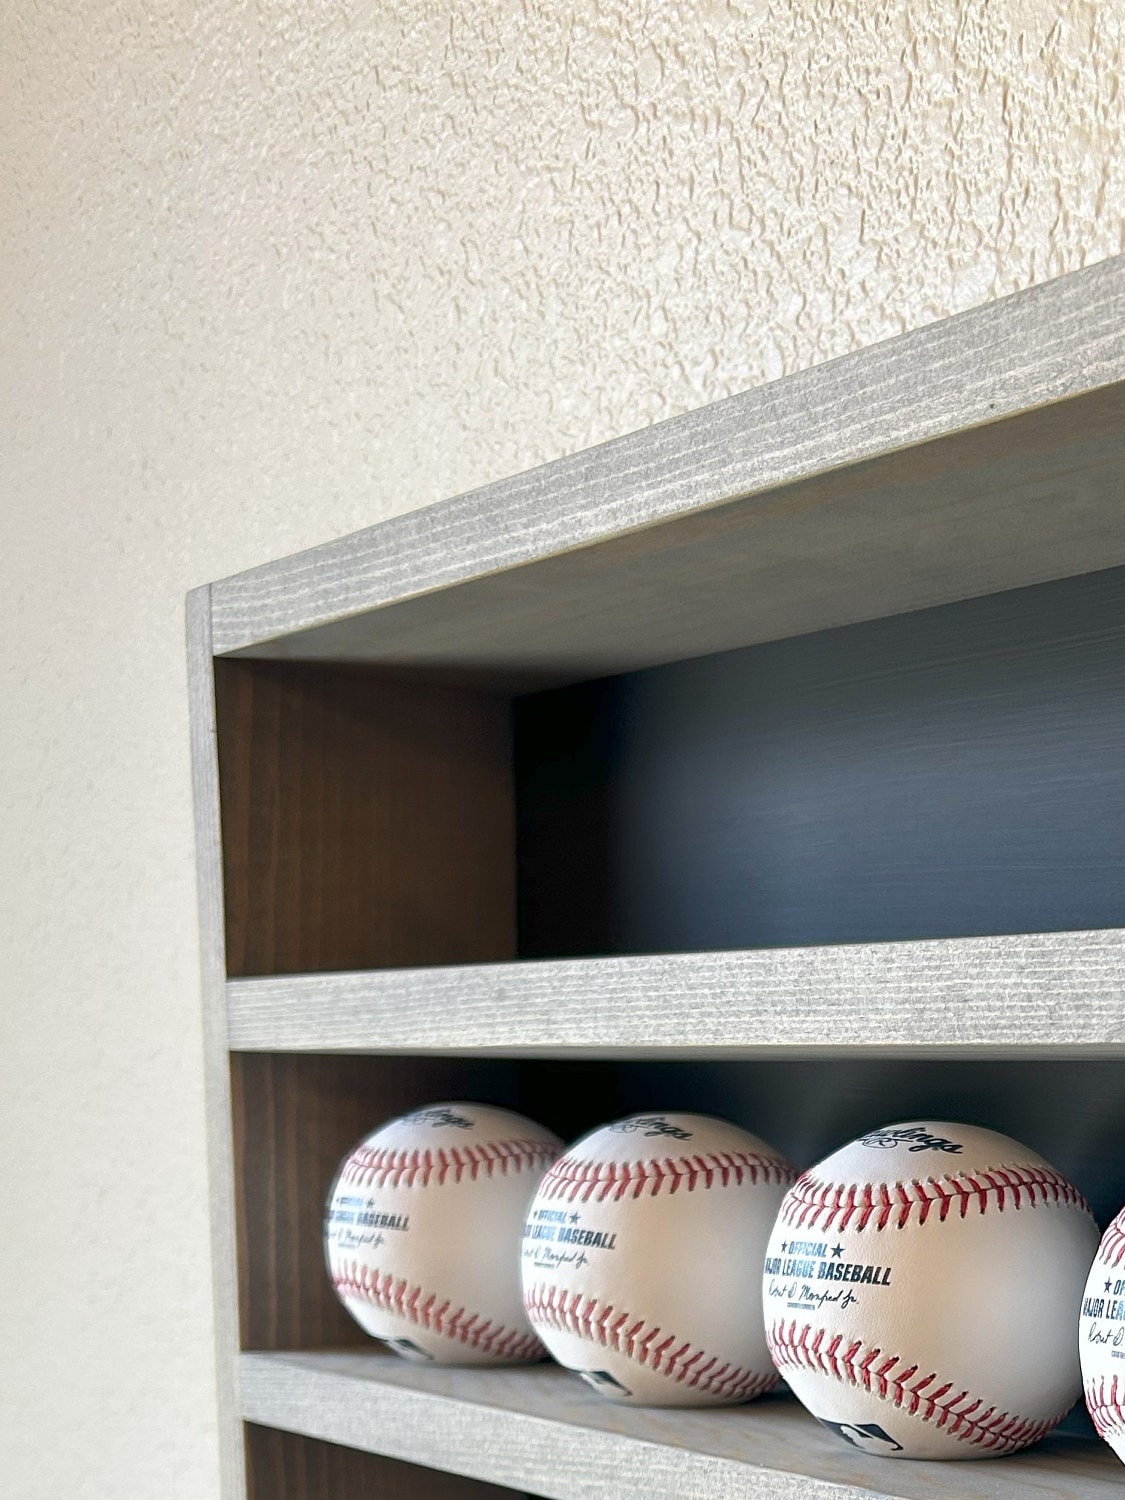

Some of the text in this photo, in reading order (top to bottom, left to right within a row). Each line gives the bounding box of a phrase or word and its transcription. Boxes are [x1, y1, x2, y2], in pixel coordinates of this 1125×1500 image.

[557, 1227, 617, 1250] BASEBALL
[788, 1241, 829, 1258] OFFICIAL
[782, 1258, 817, 1279] LEAGUE
[817, 1261, 892, 1286] BASEBALL
